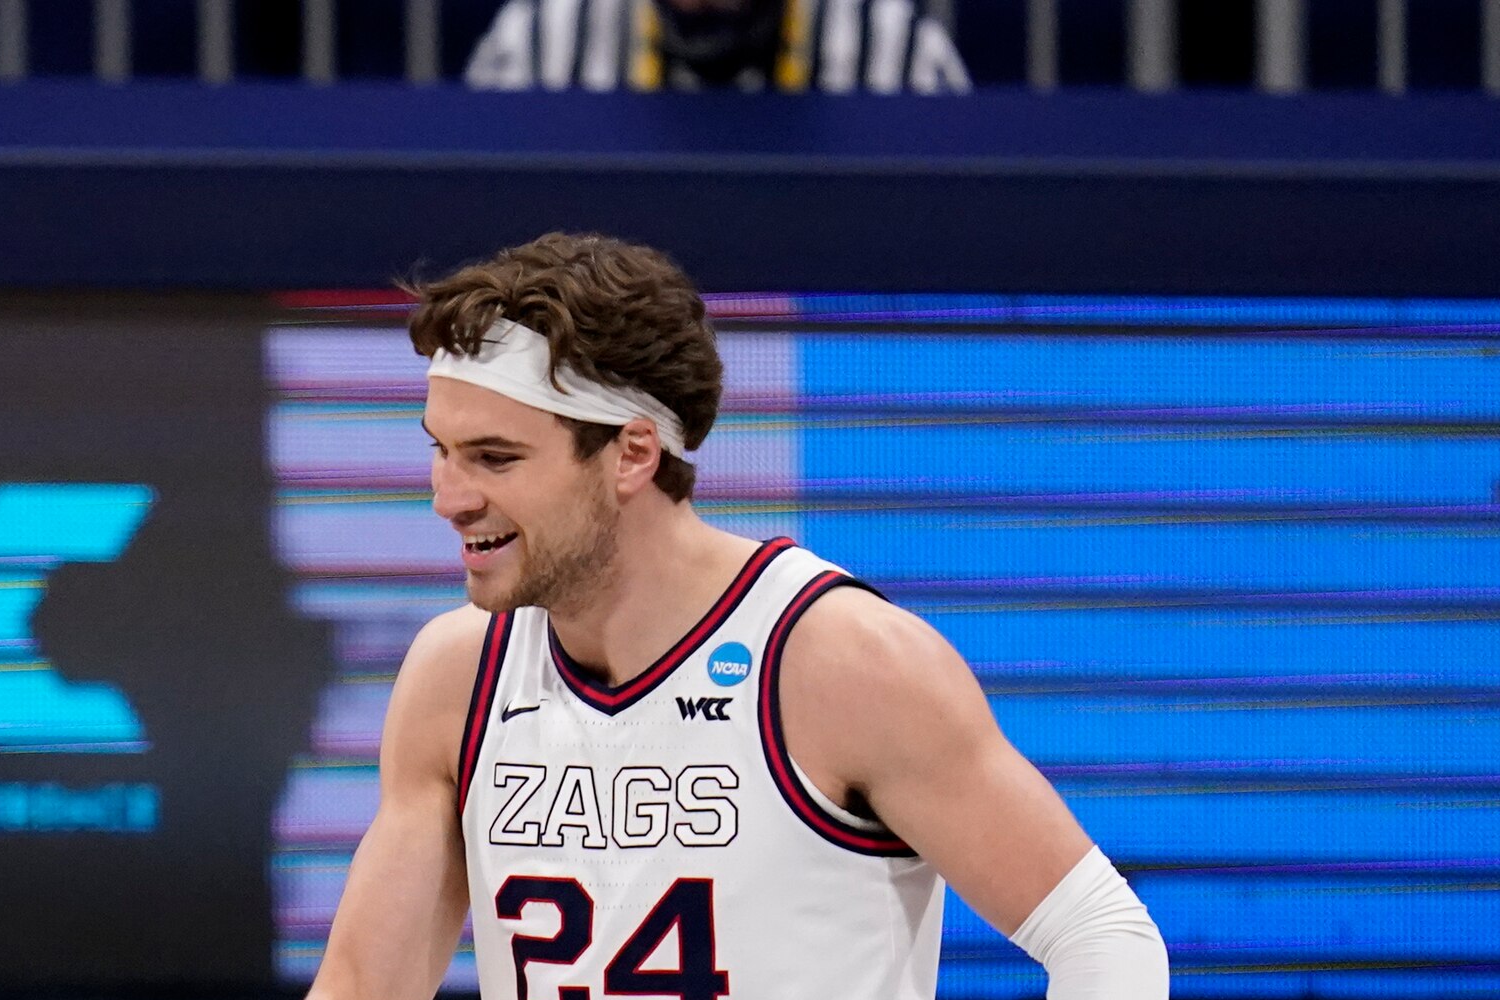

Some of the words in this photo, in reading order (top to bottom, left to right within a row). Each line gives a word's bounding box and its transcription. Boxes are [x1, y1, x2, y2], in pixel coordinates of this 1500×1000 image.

[711, 660, 748, 676] NCAA
[675, 696, 734, 722] WCC
[488, 762, 740, 850] ZAGS
